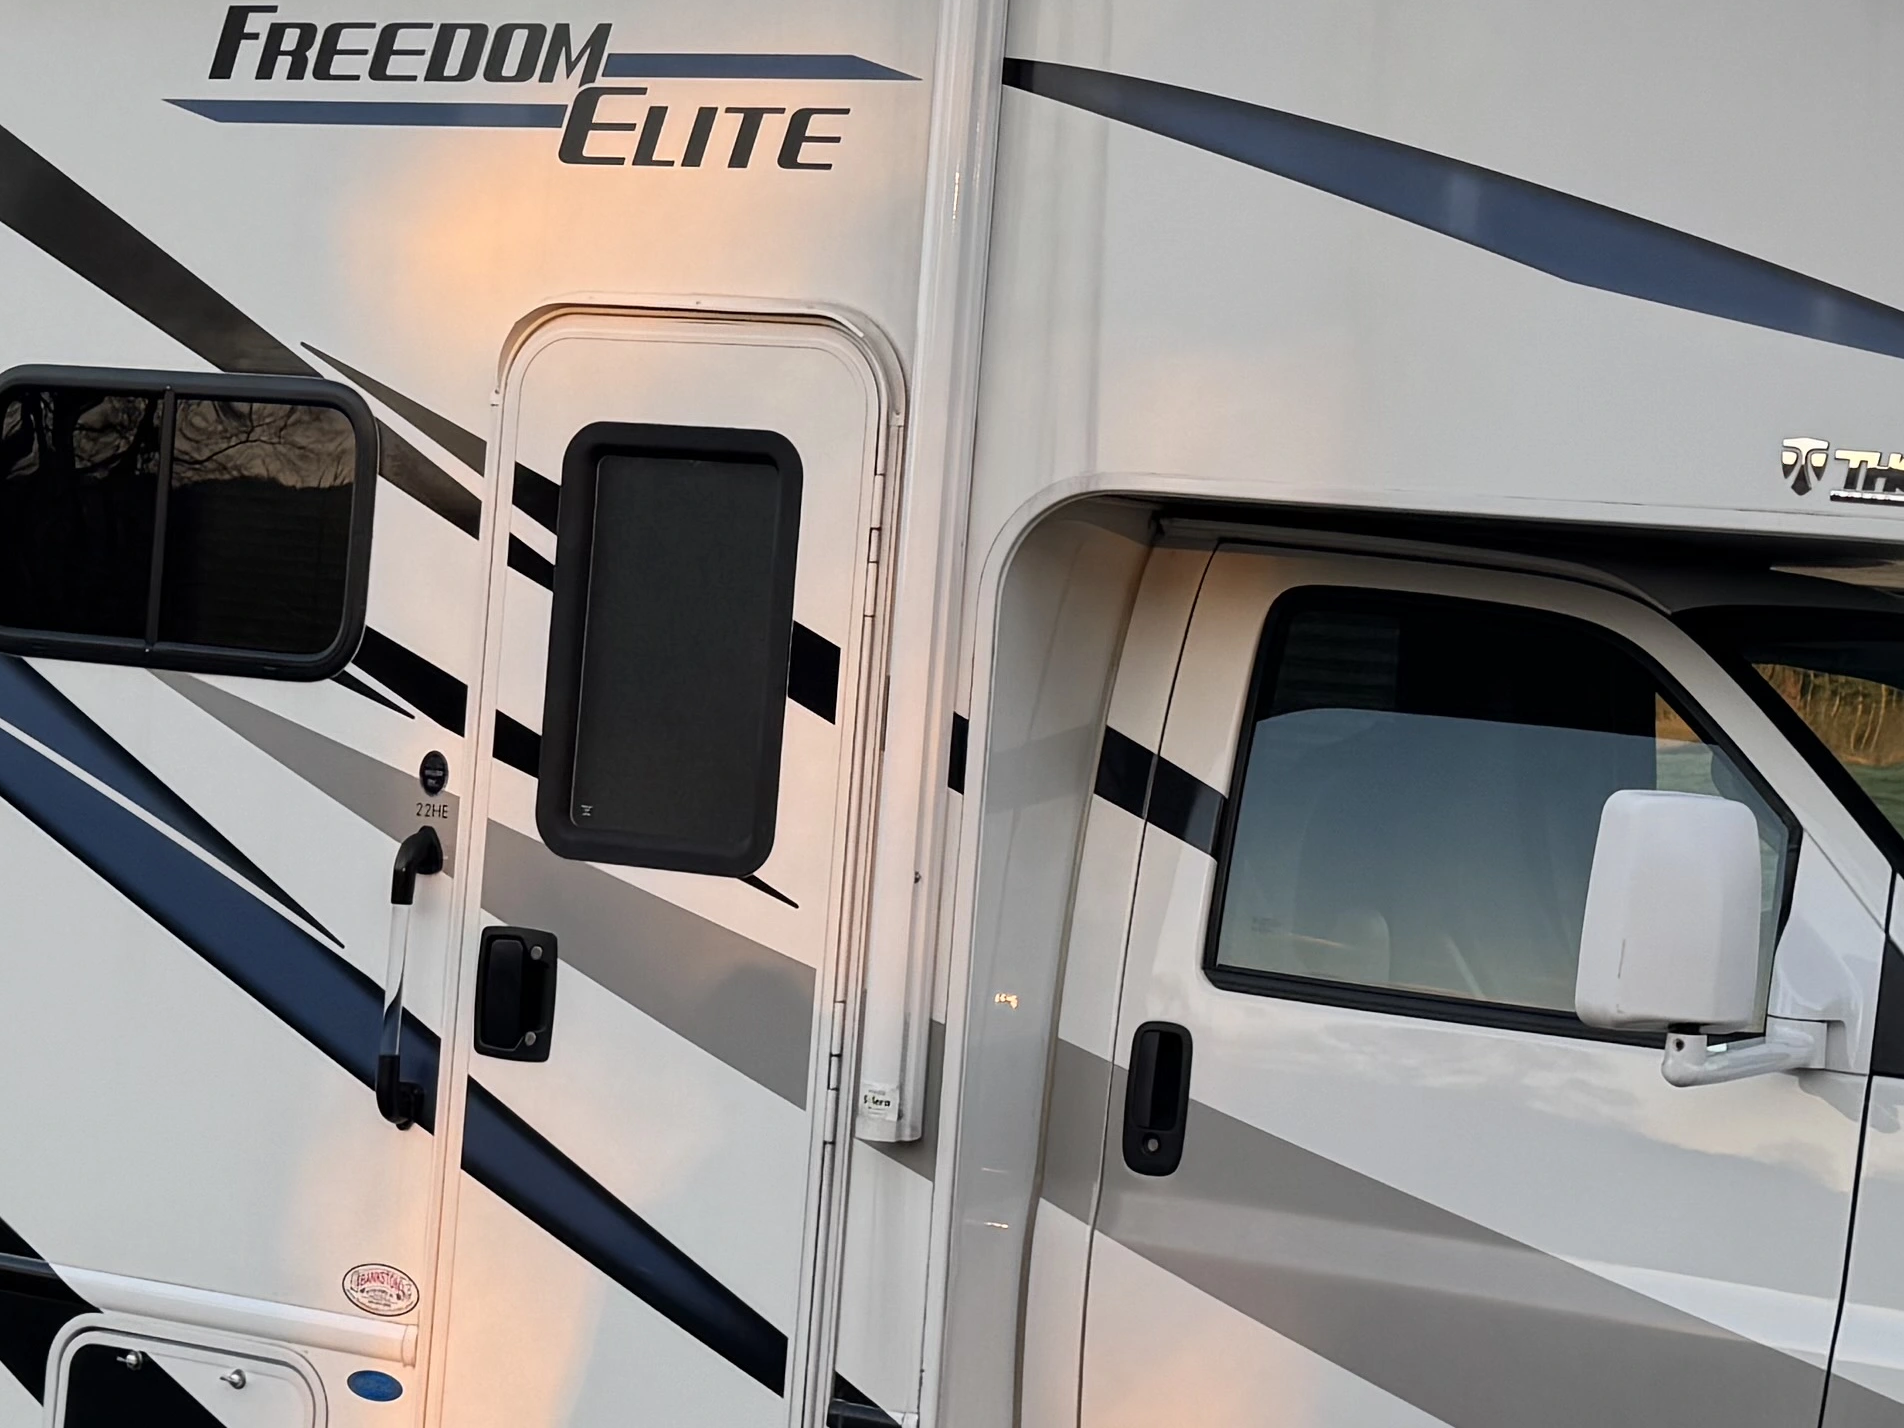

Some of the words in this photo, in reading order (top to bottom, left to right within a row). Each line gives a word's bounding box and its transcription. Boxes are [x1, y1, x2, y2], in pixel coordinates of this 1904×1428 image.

[208, 4, 613, 86] FREEDOM
[558, 86, 851, 171] ELITE
[416, 802, 448, 819] 22HE
